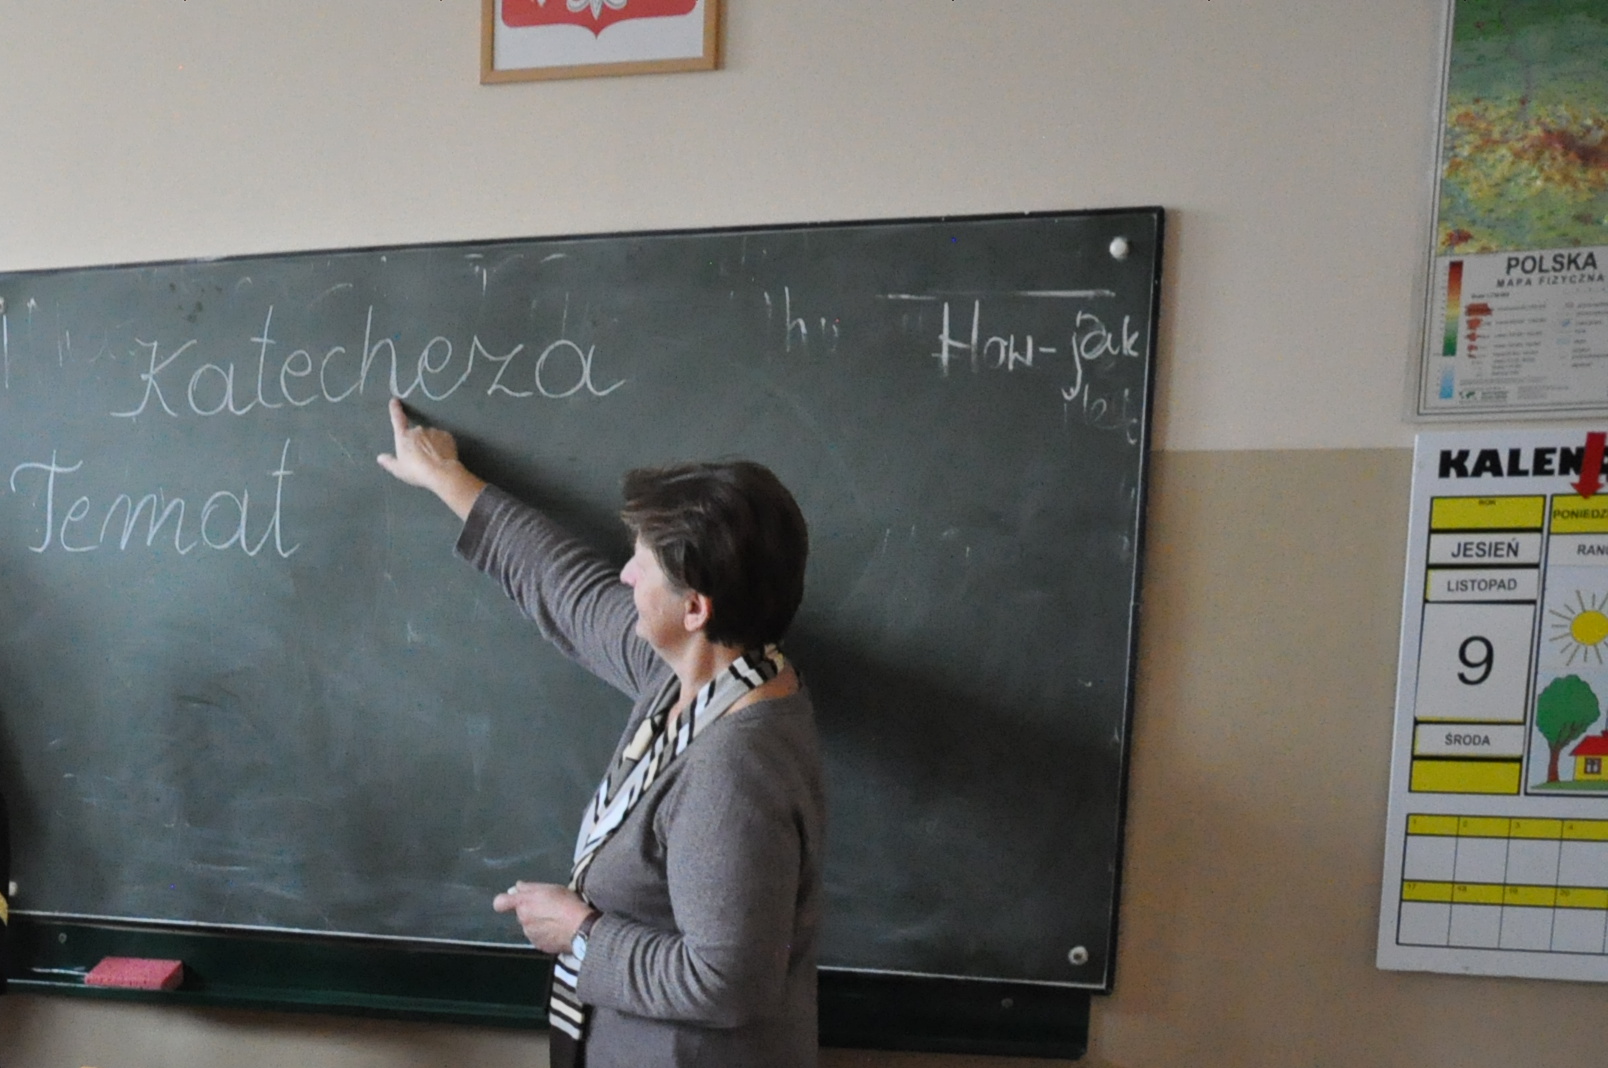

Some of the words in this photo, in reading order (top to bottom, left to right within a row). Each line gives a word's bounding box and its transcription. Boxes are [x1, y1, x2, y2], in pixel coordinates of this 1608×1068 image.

[1506, 252, 1597, 276] POLSKA
[1496, 278, 1532, 287] MAPA
[1539, 274, 1605, 285] FIZYCZNA
[110, 305, 626, 418] Katecheza
[10, 437, 300, 558] Temat
[1451, 538, 1519, 558] JESIEŃ
[1447, 578, 1517, 592] LISTOPAD
[1457, 635, 1494, 686] 9
[1445, 732, 1491, 746] ŚRODA
